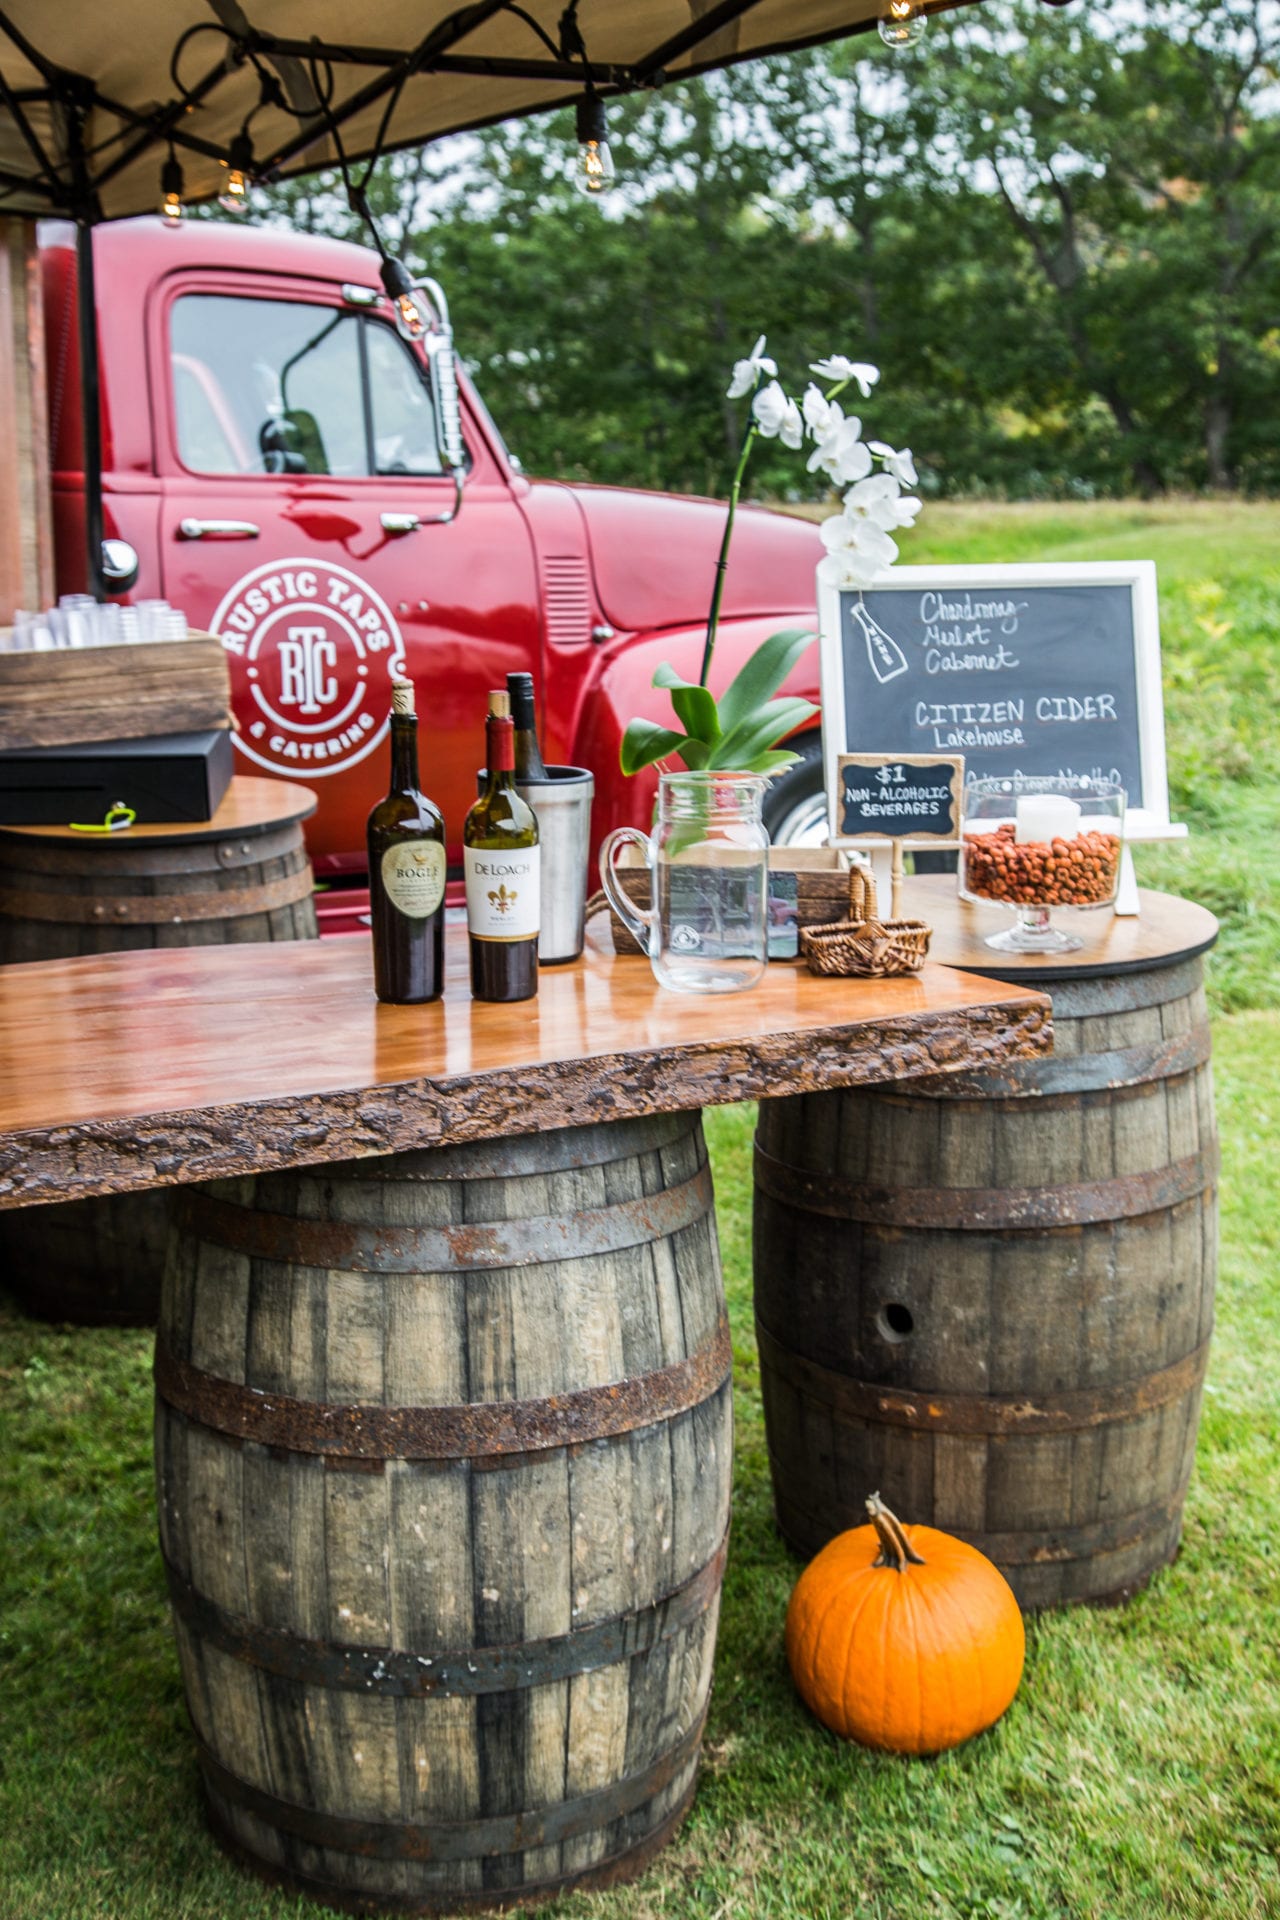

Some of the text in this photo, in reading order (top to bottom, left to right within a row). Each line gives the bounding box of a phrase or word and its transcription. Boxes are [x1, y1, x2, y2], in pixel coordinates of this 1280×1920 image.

[220, 571, 390, 656] RUSTIC TAPS
[922, 624, 991, 646] Merlot
[925, 644, 1020, 674] Cabernet
[915, 694, 1118, 726] CITIZEN CIDER
[250, 712, 375, 760] & CATERING
[933, 725, 1025, 749] Lakehouse
[875, 765, 907, 784] $1
[845, 785, 950, 803] NON-ALCOHOLIC
[860, 801, 940, 818] BEVERAGES
[396, 866, 440, 879] BOGLE
